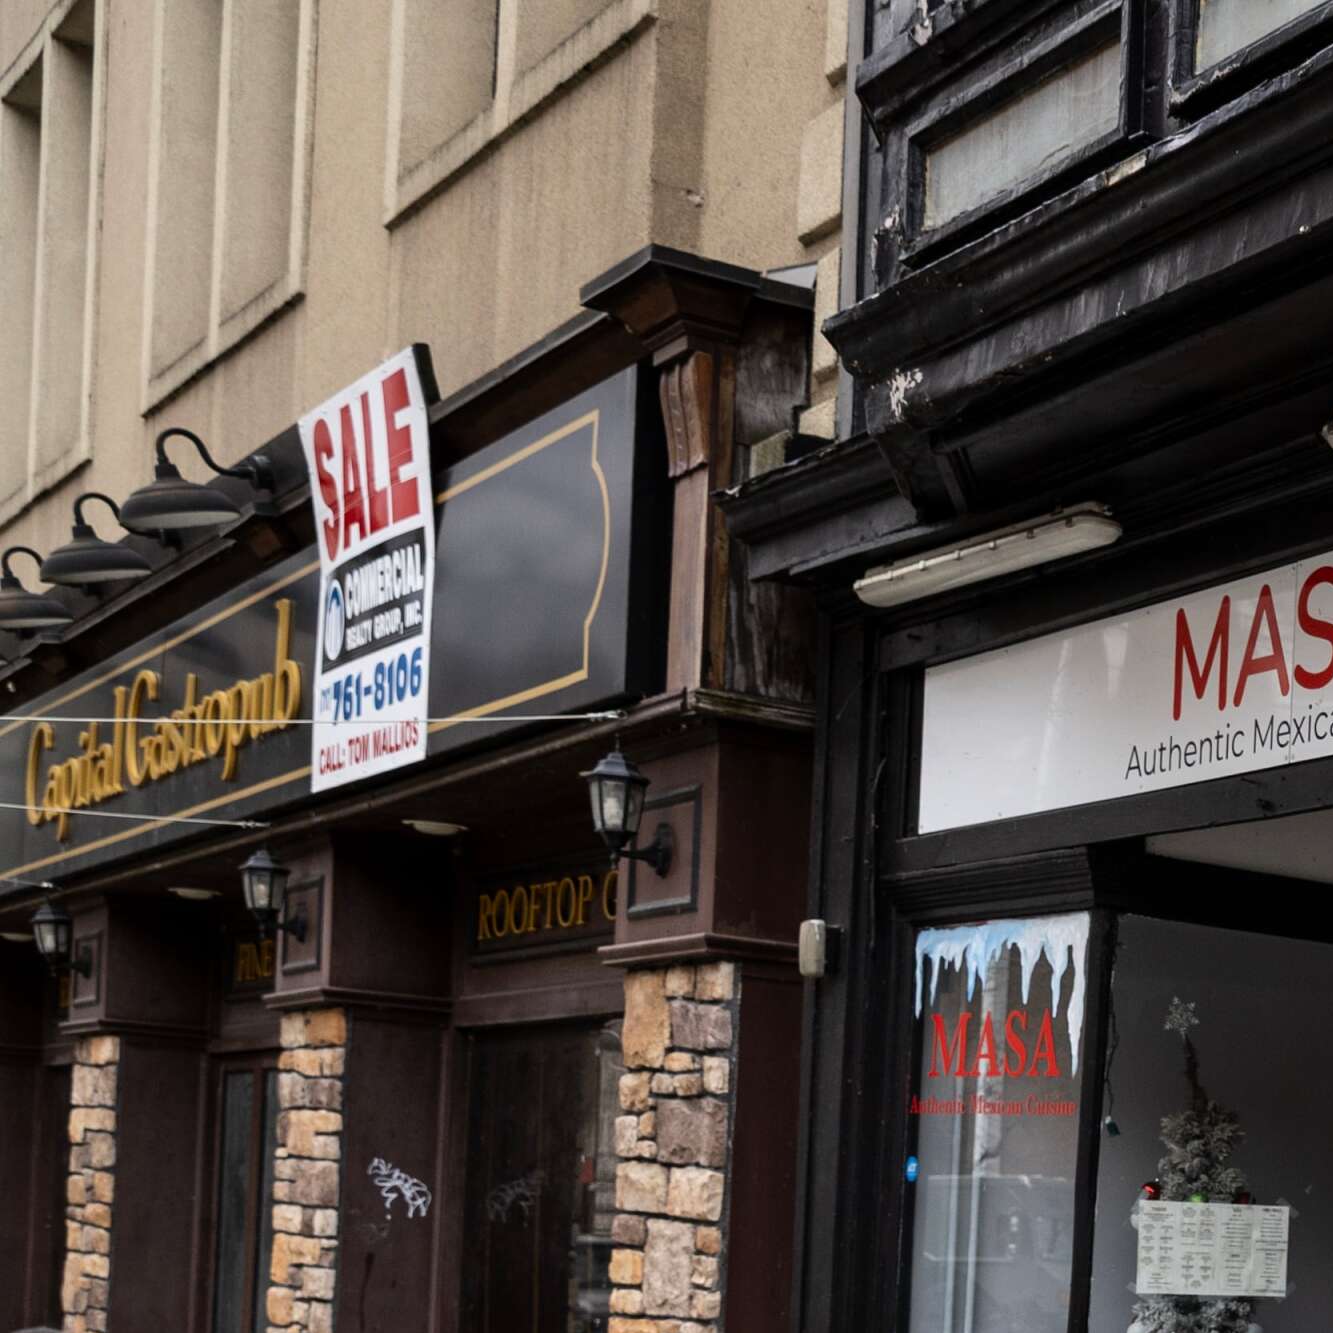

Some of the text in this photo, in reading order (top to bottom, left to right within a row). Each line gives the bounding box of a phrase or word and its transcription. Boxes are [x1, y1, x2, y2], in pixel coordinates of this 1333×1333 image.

[313, 368, 420, 561] SALE
[345, 543, 424, 620] COMMERCIAL
[26, 598, 302, 841] Capital Gastropub
[333, 647, 422, 725] 761-8106
[1124, 723, 1245, 780] Authentic
[477, 875, 593, 941] ROOFTOP
[928, 1008, 1061, 1078] MASA
